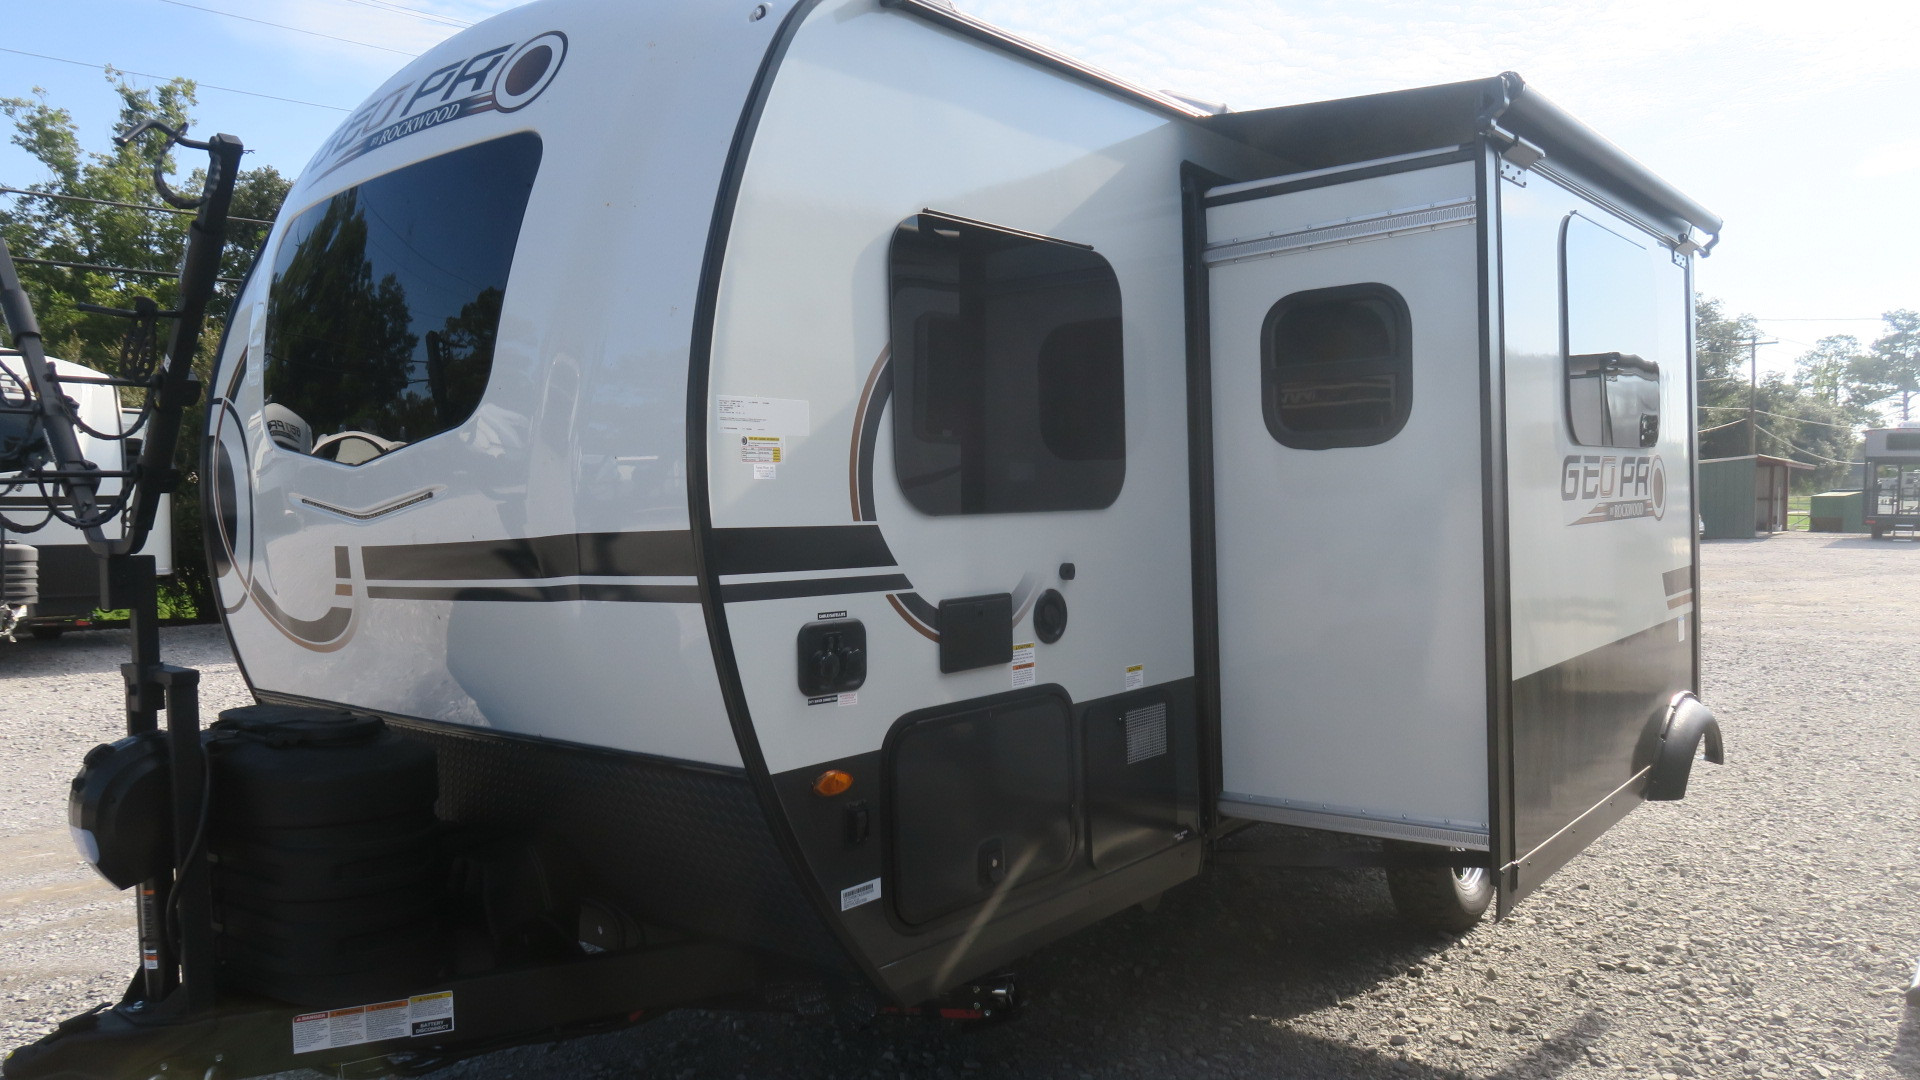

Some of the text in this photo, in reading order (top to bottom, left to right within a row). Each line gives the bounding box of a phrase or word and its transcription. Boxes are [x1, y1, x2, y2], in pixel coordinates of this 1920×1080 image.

[399, 30, 568, 118] PRO
[379, 103, 461, 145] ROCKWOOD
[1561, 454, 1666, 521] GEO PRO
[1614, 502, 1644, 517] ROCKWOOD
[301, 1013, 326, 1021] DANGER
[420, 1020, 444, 1028] BATTERY
[416, 1024, 449, 1034] DISCONNECT
